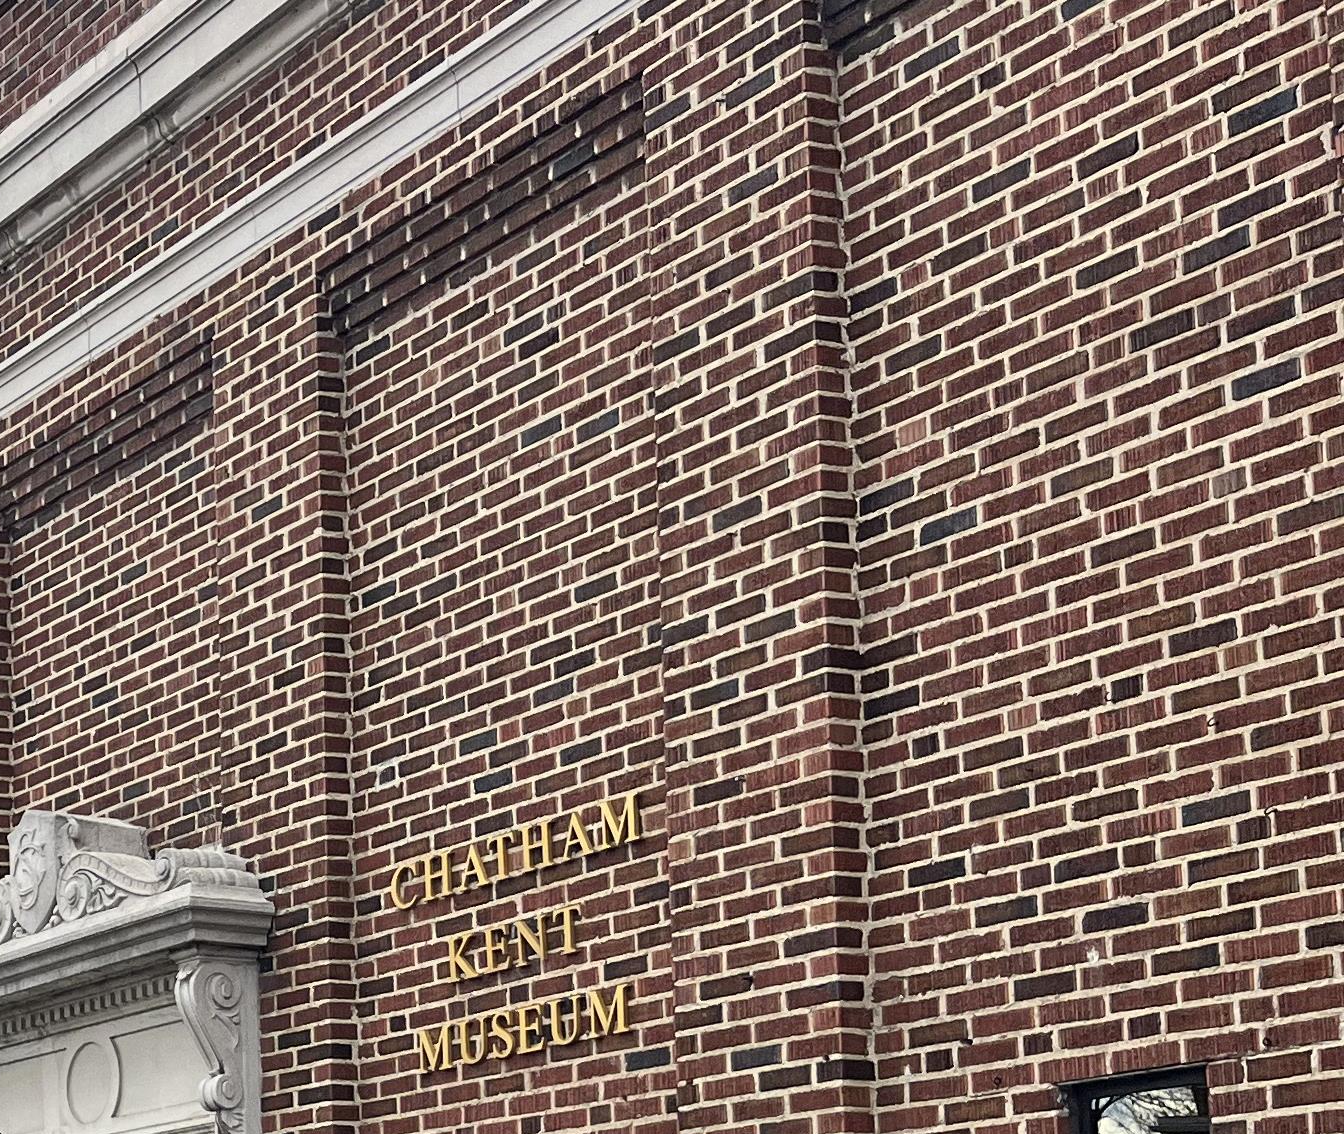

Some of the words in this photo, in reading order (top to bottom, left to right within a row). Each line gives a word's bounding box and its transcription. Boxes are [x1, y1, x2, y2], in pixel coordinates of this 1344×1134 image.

[390, 791, 643, 911] CHATHAM
[446, 903, 582, 982] KENT
[417, 983, 633, 1074] MUSEUM
